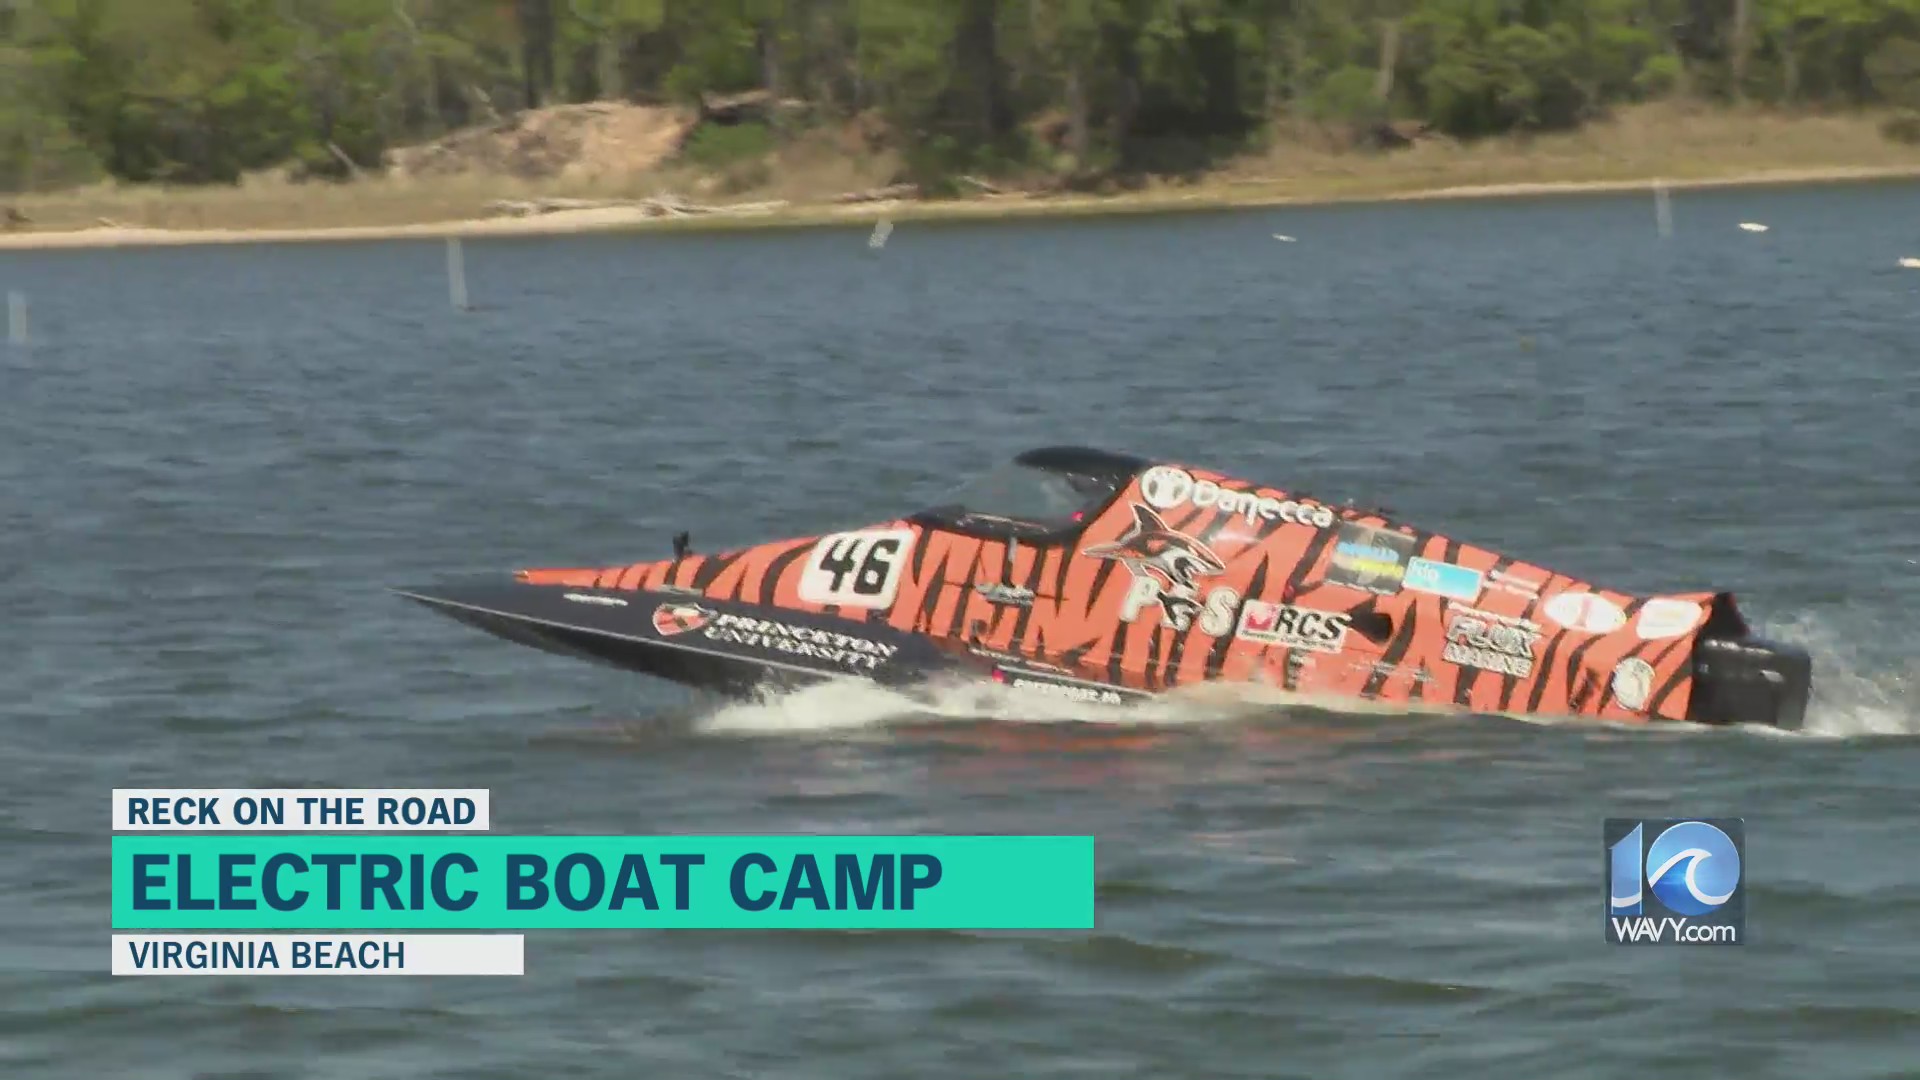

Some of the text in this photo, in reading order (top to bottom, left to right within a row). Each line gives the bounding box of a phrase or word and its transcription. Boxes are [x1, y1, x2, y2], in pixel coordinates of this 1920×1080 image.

[818, 537, 900, 594] 46
[715, 613, 899, 657] PRINCETON
[1275, 606, 1353, 640] RCS
[704, 626, 888, 669] UNIVERSITY
